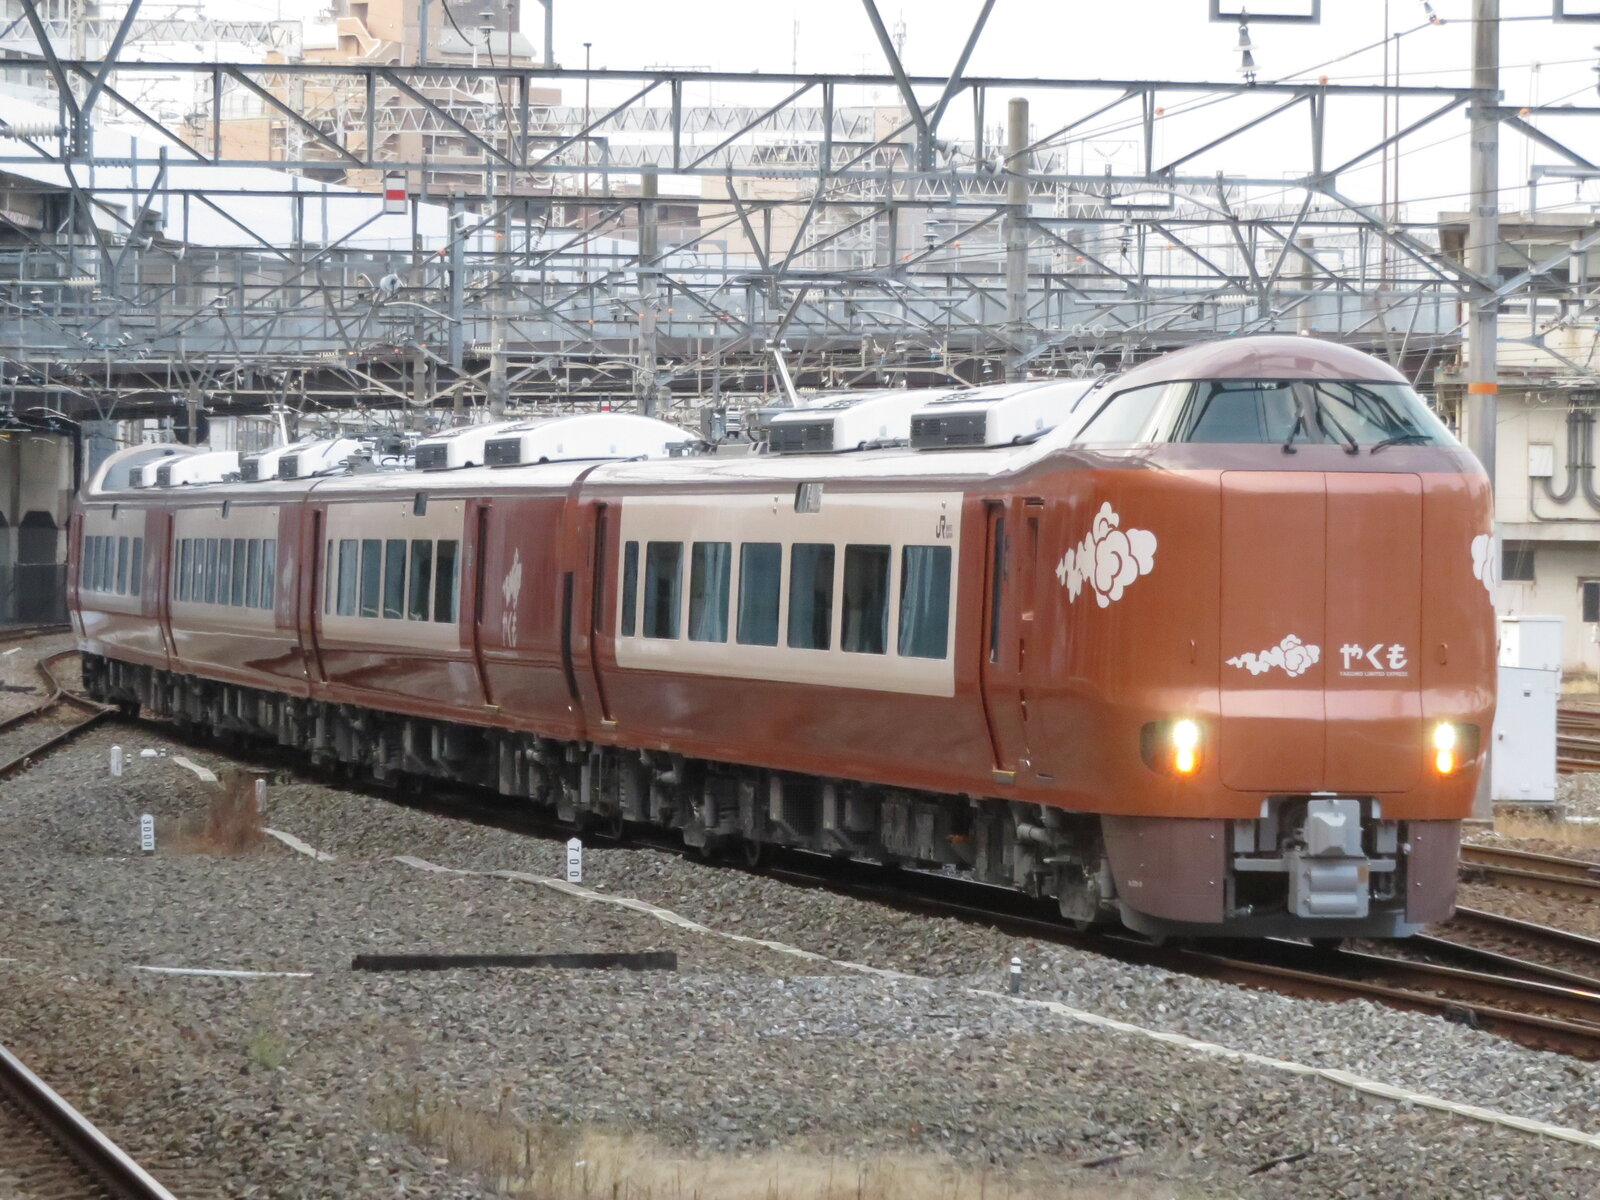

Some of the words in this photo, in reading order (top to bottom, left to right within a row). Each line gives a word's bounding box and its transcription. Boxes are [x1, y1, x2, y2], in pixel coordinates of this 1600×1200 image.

[935, 515, 946, 539] JR
[1340, 643, 1408, 669] やくも
[143, 819, 152, 847] 3000
[569, 846, 580, 877] 700
